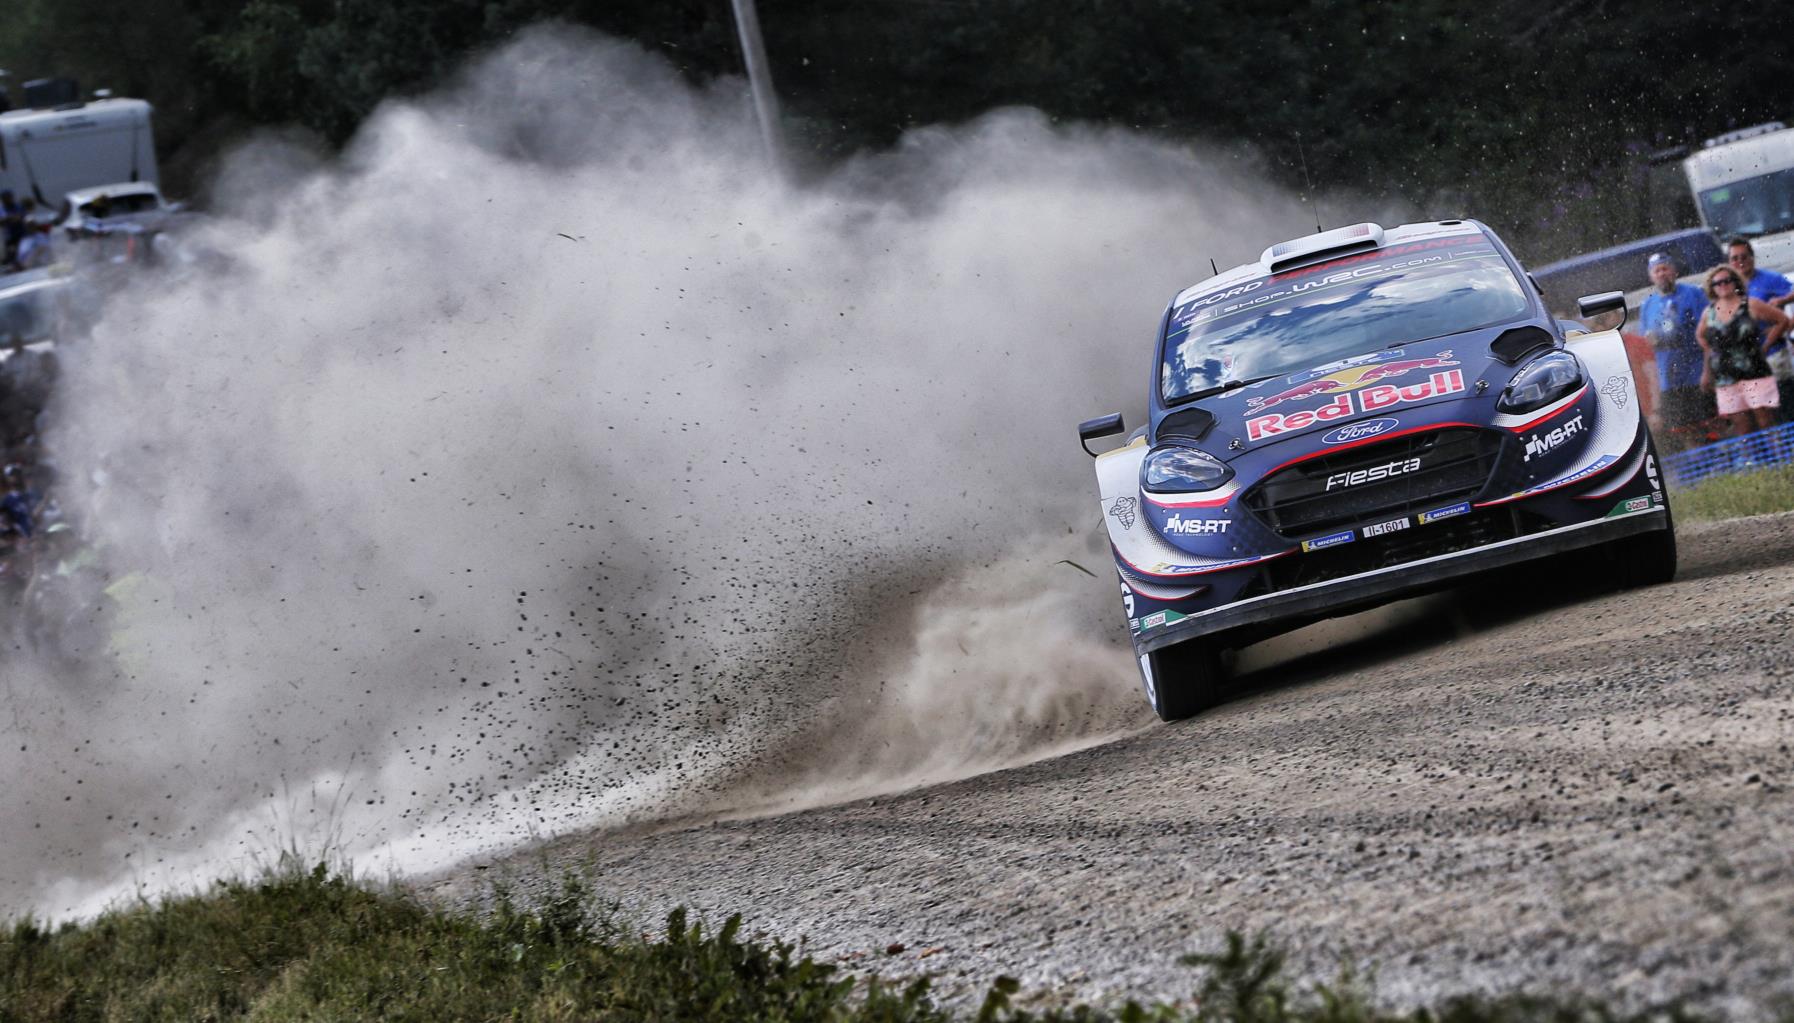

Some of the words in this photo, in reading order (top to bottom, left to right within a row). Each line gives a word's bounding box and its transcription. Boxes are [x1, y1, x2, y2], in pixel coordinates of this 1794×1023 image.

[1190, 281, 1263, 312] FORD
[1246, 393, 1354, 441] Red
[1357, 368, 1466, 413] Bull
[1336, 420, 1384, 441] Ford
[1535, 414, 1583, 455] MS-RT
[1325, 457, 1421, 492] Fiesta
[1433, 505, 1466, 519] MICHELIN
[1173, 519, 1232, 533] MS-RT
[1316, 534, 1351, 547] MICHELIN
